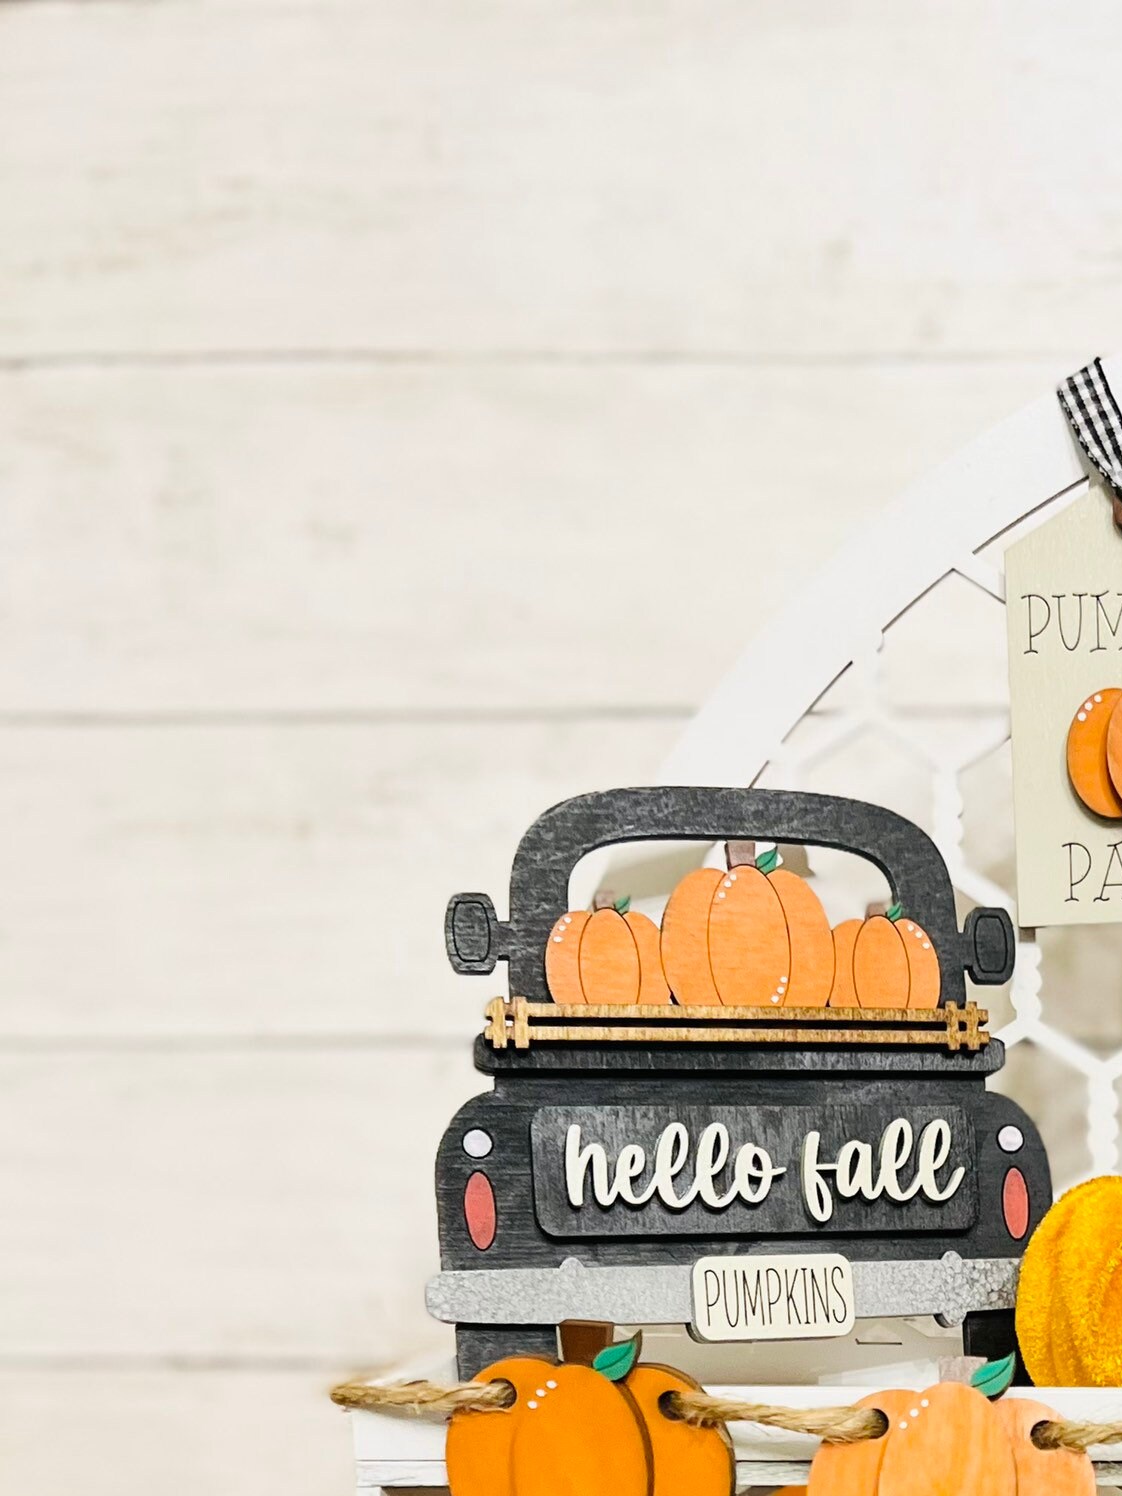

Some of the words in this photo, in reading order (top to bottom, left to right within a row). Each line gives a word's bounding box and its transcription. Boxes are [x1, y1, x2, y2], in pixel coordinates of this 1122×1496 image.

[565, 1121, 787, 1209] hello
[803, 1117, 965, 1223] fall
[704, 1266, 847, 1329] PUMPKINS
